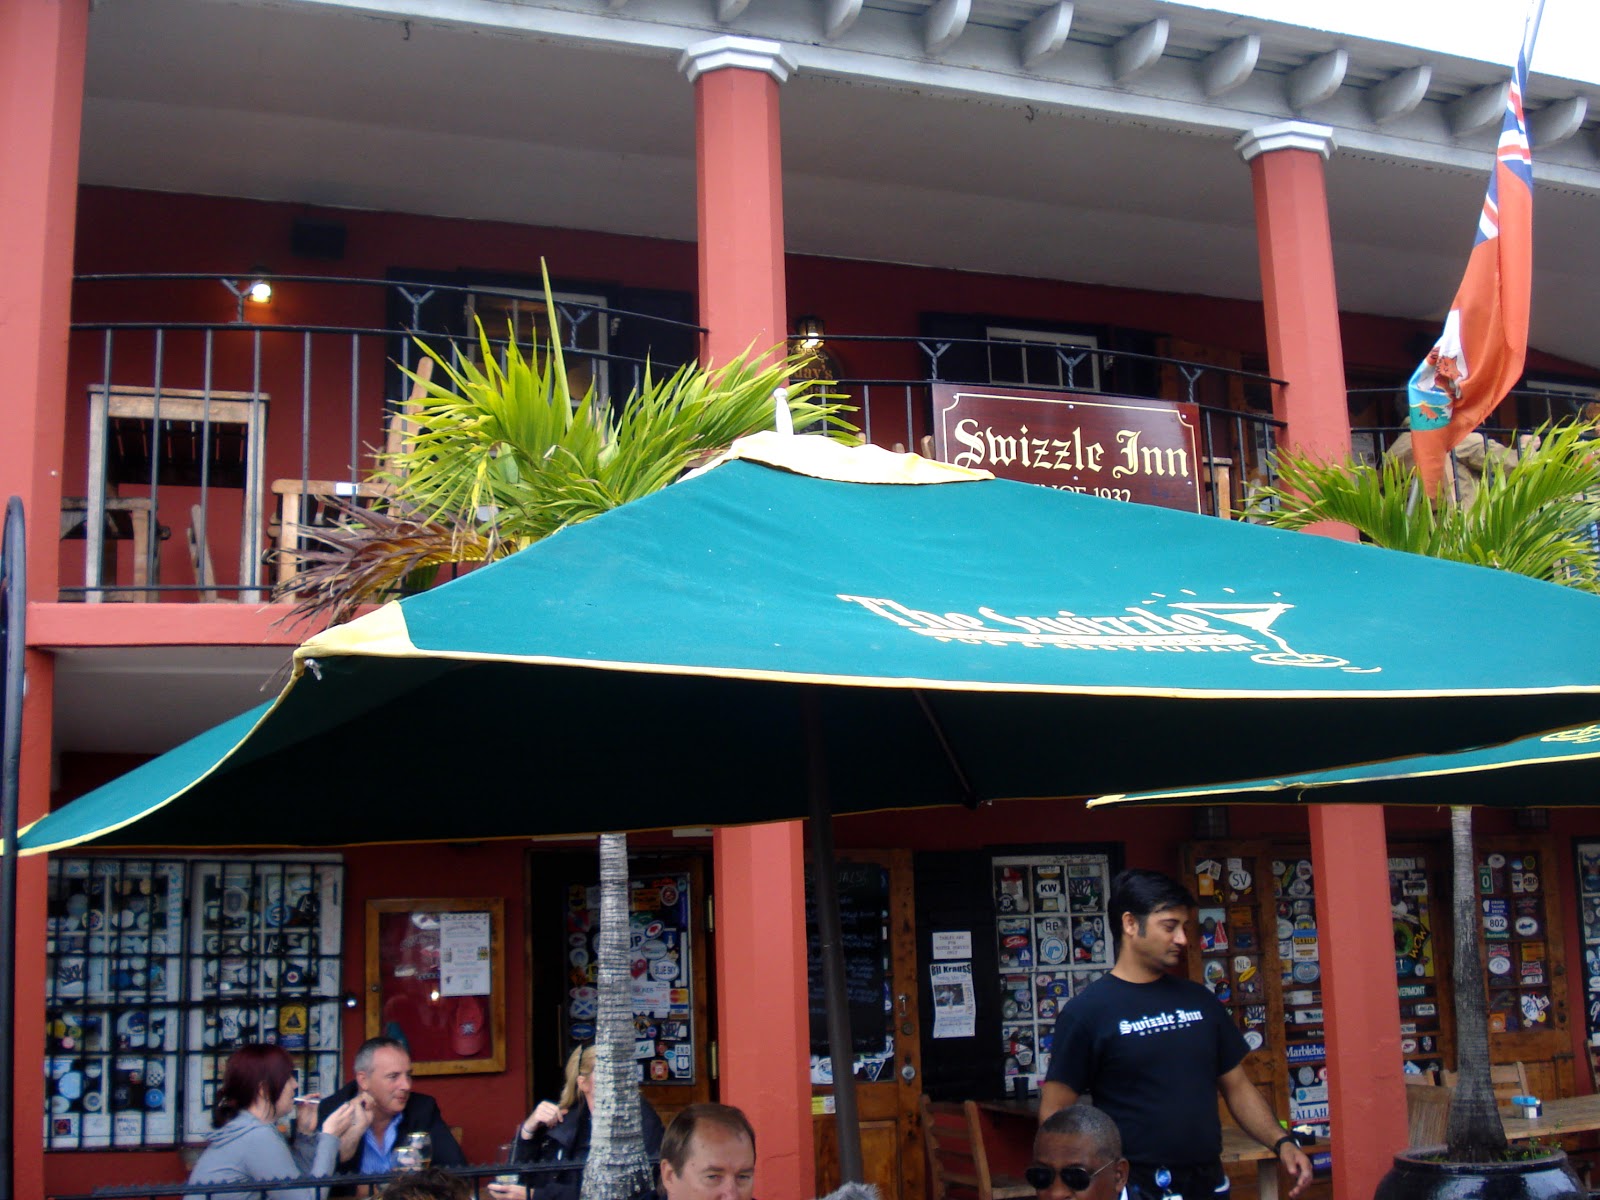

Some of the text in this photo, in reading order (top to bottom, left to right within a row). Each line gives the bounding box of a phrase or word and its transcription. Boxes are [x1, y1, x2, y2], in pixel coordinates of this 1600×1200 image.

[954, 418, 1189, 479] Swizzle Inn
[836, 594, 1000, 632] The
[1040, 884, 1057, 892] KW
[1232, 873, 1248, 887] SV
[1489, 919, 1505, 928] 802
[1119, 1012, 1175, 1035] Swizzle
[1175, 1009, 1204, 1023] Inn
